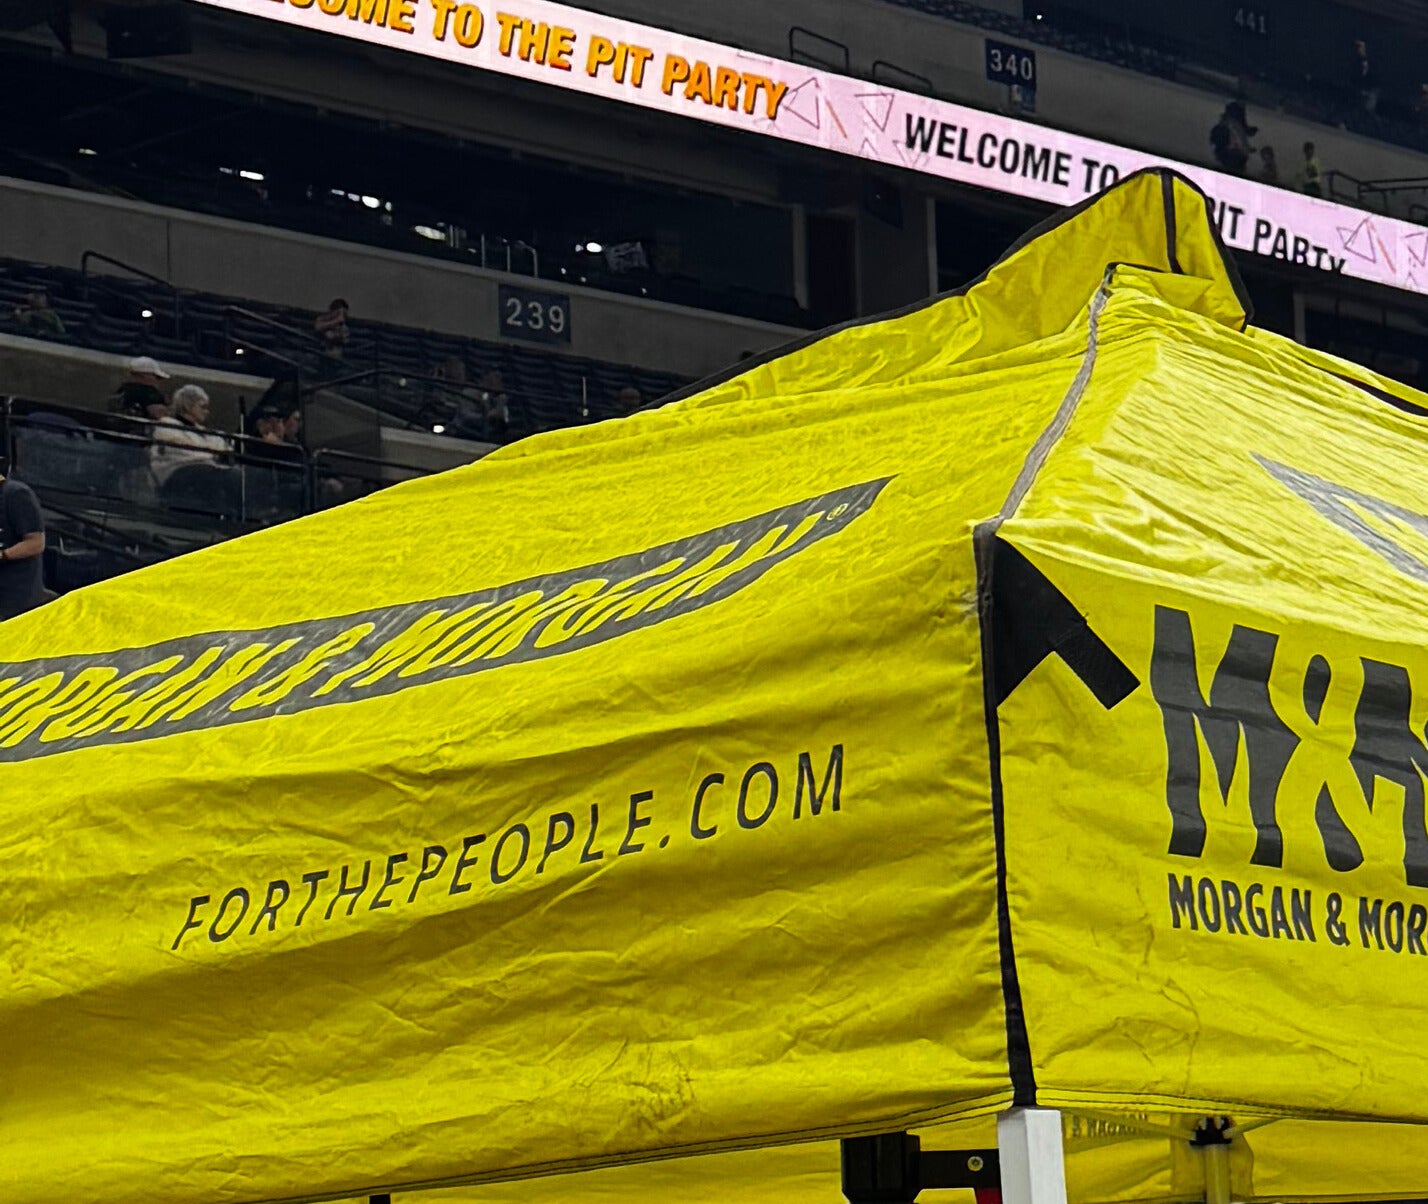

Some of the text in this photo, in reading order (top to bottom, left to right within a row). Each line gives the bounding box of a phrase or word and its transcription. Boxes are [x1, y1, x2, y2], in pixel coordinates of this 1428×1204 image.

[431, 0, 485, 48] TO
[496, 12, 577, 71] THE
[585, 34, 653, 88] PIT
[661, 56, 788, 119] PARTY
[991, 49, 1033, 82] 340
[1234, 7, 1268, 34] 441
[904, 112, 1073, 188] WELCOME
[1081, 157, 1119, 195] TO
[1210, 196, 1243, 240] IT
[506, 297, 565, 333] 239
[0, 510, 826, 748] ORGAN & MORGAN
[171, 744, 846, 951] FORTHEPEOPLE.COM
[1168, 873, 1317, 943] MORGAN
[1325, 892, 1350, 948] &
